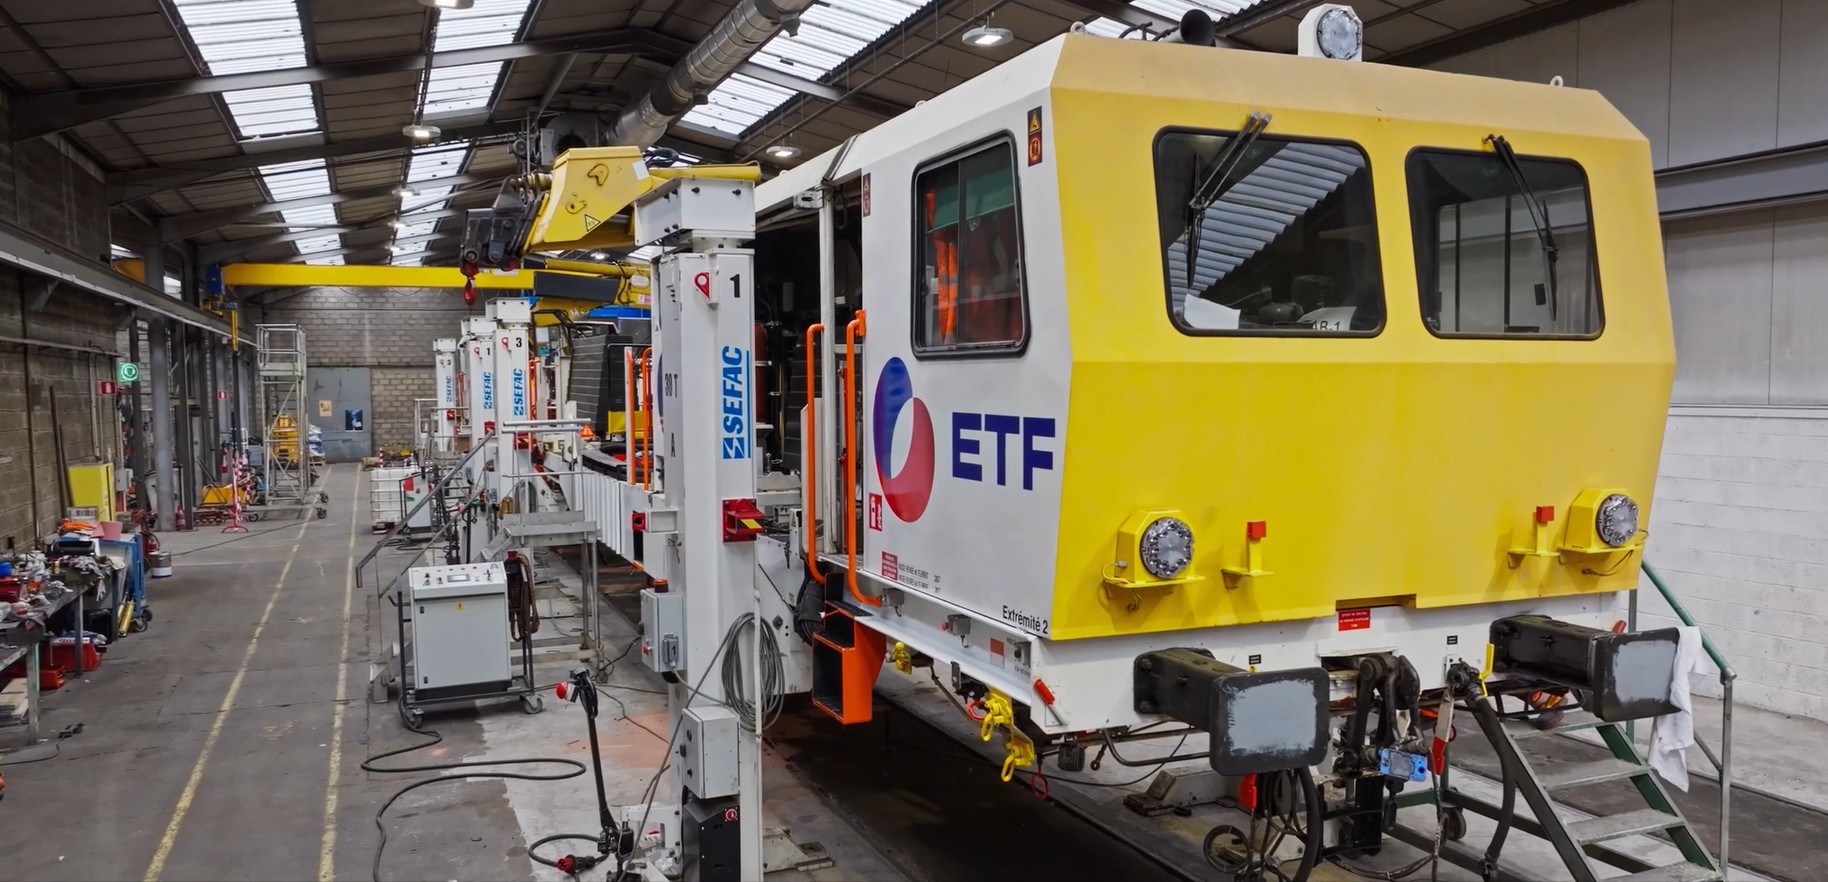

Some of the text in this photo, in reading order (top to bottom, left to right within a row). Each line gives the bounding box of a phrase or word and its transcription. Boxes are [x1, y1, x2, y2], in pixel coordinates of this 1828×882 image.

[729, 274, 741, 298] 1
[486, 347, 491, 356] 1
[515, 336, 523, 348] 3
[483, 371, 493, 403] SEFAC
[512, 367, 524, 406] SEFAC
[722, 345, 744, 435] SEFAC
[670, 432, 676, 458] A
[952, 411, 1056, 491] ETF
[1002, 604, 1049, 635] Extrémité 2
